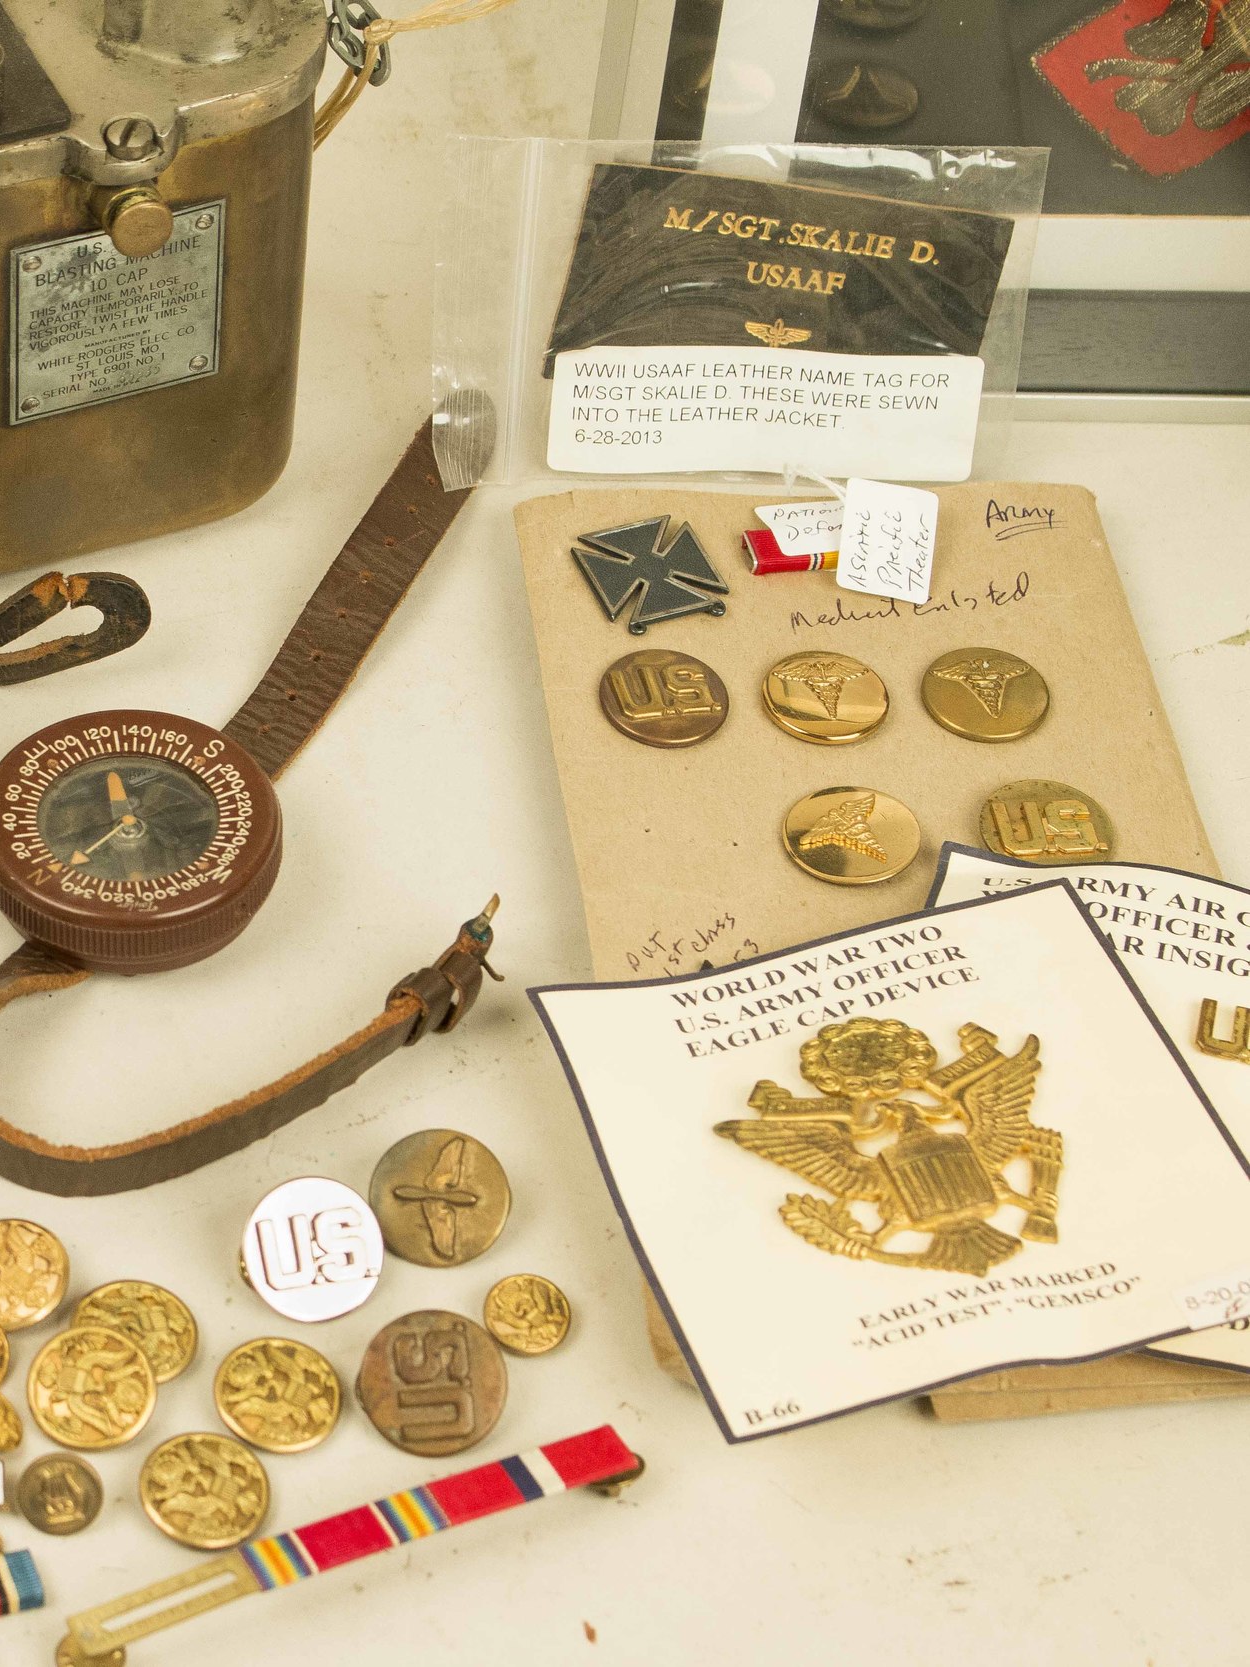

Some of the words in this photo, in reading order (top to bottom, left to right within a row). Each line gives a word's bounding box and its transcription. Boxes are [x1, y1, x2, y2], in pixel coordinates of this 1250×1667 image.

[77, 241, 106, 258] U.S.
[908, 239, 940, 265] D.
[35, 257, 116, 287] BLASTING
[90, 278, 108, 292] 10
[116, 267, 148, 286] CAP
[747, 260, 846, 296] USAAF
[29, 307, 89, 330] CAPACITY
[183, 281, 199, 292] TO
[30, 306, 57, 320] THIS
[61, 292, 114, 312] MACHINE
[120, 284, 144, 298] MAY
[150, 275, 181, 291] LOSE
[92, 309, 127, 324] TWIST
[135, 302, 156, 315] THE
[161, 289, 209, 308] HANDLE
[29, 325, 106, 351] VIGOROUSLY
[110, 322, 118, 332] A
[122, 314, 149, 329] FEW
[154, 304, 188, 320] TIMES
[38, 340, 135, 371] WHITE-RODGERS
[140, 331, 170, 346] ELEC
[177, 325, 195, 336] CO
[76, 361, 91, 371] ST
[141, 344, 159, 355] MO
[71, 369, 98, 382] TYPE
[104, 361, 130, 375] 6901
[136, 355, 154, 367] NO
[575, 363, 626, 378] WWII
[633, 363, 696, 378] USAAF
[702, 363, 793, 381] LEATHER
[800, 368, 855, 387] NAME
[863, 373, 903, 388] TAG
[909, 373, 950, 388] FOR
[42, 383, 83, 399] SERIAL
[89, 377, 107, 388] NO
[573, 385, 636, 401] M/SGT
[642, 385, 708, 400] SKALIE
[714, 385, 732, 400] D.
[739, 385, 805, 404] THESE
[811, 391, 872, 409] WERE
[879, 395, 939, 410] SEWN
[572, 406, 619, 423] INTO
[626, 408, 663, 423] THE
[669, 406, 758, 422] LEATHER
[765, 409, 845, 430] JACKET.
[575, 429, 663, 445] 6-28-2013
[83, 725, 111, 740] 120
[122, 724, 152, 736] 140
[159, 729, 188, 746] 160
[24, 740, 50, 760] E
[48, 735, 78, 754] 100
[203, 739, 225, 758] S
[19, 759, 40, 777] 80
[219, 764, 245, 790] 200
[5, 784, 22, 801] 60
[235, 791, 253, 818] 220
[2, 812, 17, 831] 40
[232, 820, 252, 847] 240
[11, 841, 31, 859] 20
[180, 873, 208, 892] 280
[205, 865, 233, 885] W
[61, 881, 96, 900] 340
[100, 891, 135, 903] 320
[142, 886, 179, 901] 300
[1076, 877, 1158, 902] RMY
[1166, 893, 1226, 920] AIR
[1086, 901, 1236, 948] OFFICER
[670, 969, 786, 1010] WORLD
[791, 946, 868, 977] WAR
[869, 925, 943, 955] TWO
[674, 1011, 730, 1035] U.S.
[738, 982, 823, 1022] ARMY
[833, 945, 968, 991] OFFICER
[685, 1018, 791, 1059] EAGLE
[797, 999, 856, 1027] CAP
[863, 966, 981, 1009] DEVICE
[859, 1294, 939, 1330] EARLY
[946, 1280, 1006, 1301] WAR
[1009, 1262, 1117, 1290] MARKED
